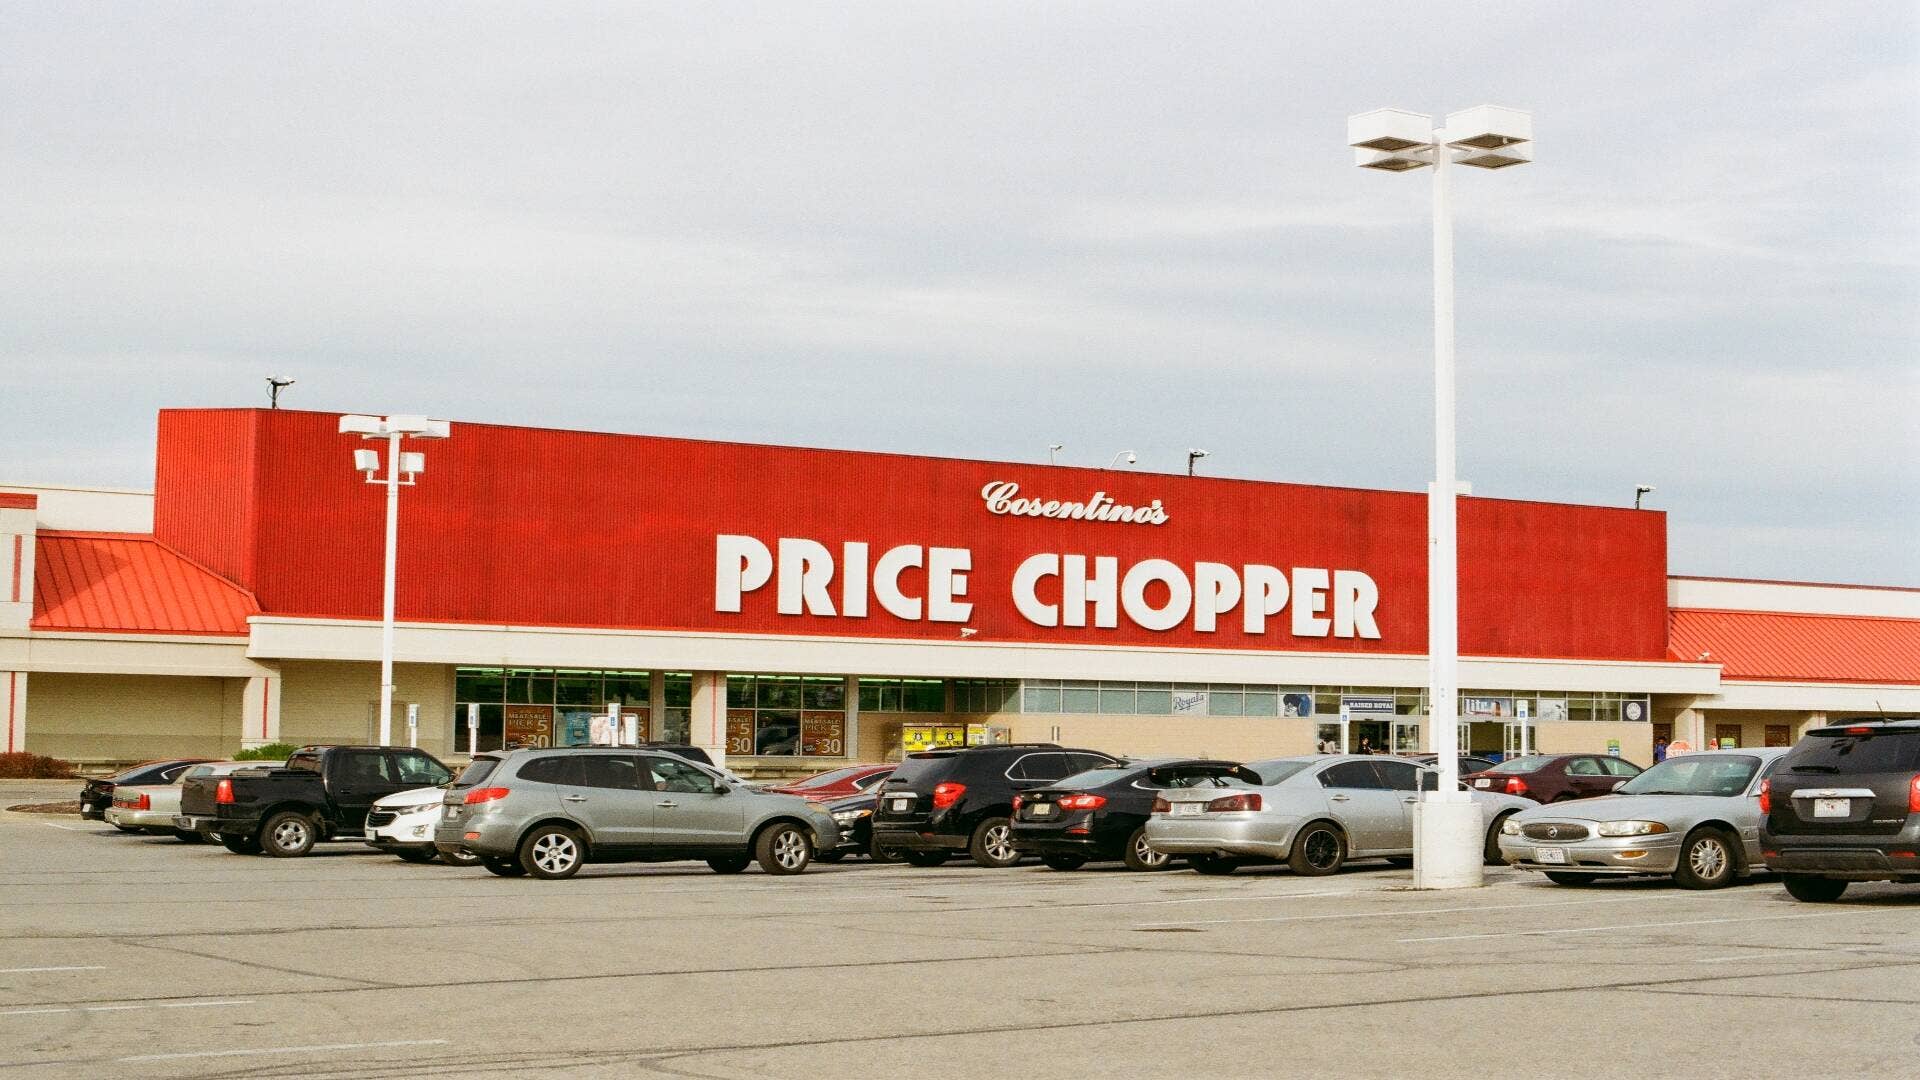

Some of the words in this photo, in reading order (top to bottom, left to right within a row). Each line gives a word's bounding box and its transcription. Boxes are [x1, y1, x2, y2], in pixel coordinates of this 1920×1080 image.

[981, 481, 1169, 525] Cosentino's
[715, 534, 974, 623] PRICE
[1012, 553, 1382, 639] CHOPPER
[1173, 691, 1204, 710] Royals
[537, 719, 548, 731] 5
[740, 723, 750, 735] 5
[830, 724, 841, 736] 5
[815, 738, 841, 754] $30
